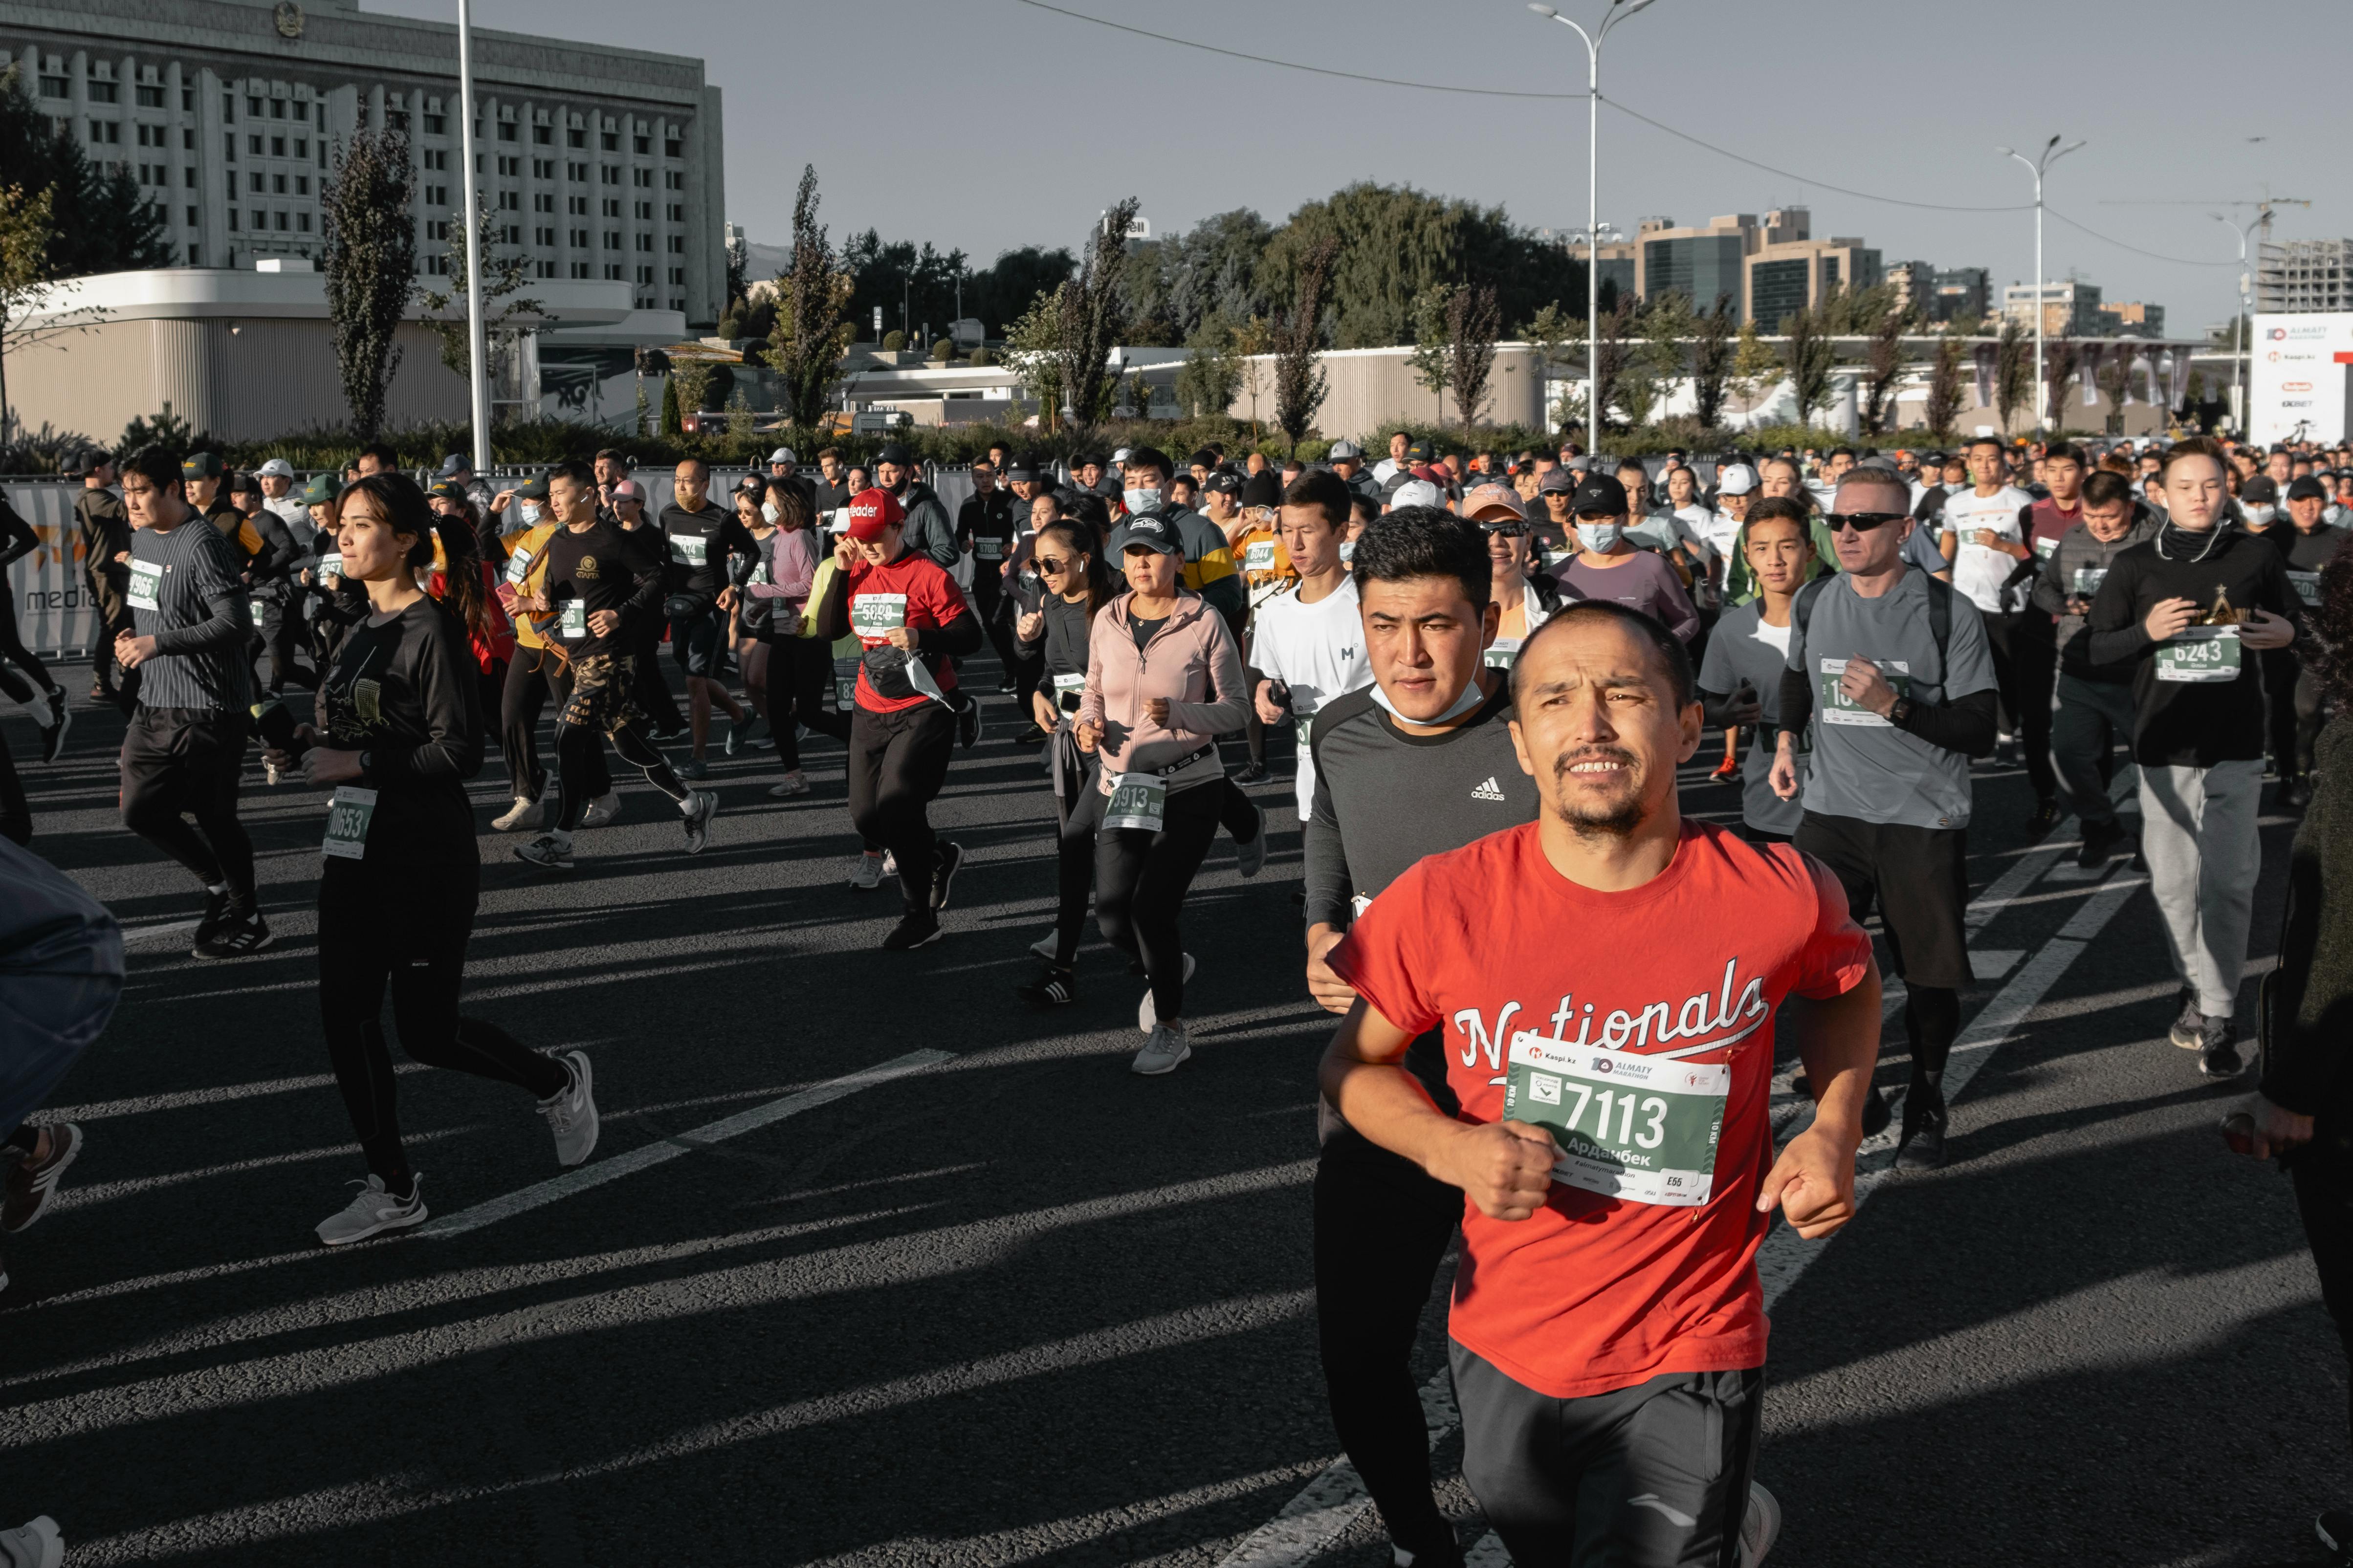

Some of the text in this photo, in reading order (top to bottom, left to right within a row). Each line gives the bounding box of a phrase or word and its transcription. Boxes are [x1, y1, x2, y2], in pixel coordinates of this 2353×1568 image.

[980, 544, 997, 553] 8700
[2175, 641, 2222, 661] 6243
[1114, 787, 1148, 808] 5913
[1471, 790, 1505, 801] adidas
[329, 807, 363, 838] 10653
[1545, 1053, 1576, 1064] Kaspi.kz
[1613, 1070, 1649, 1080] MARATHON
[1615, 1062, 1652, 1074] ALMATY
[1565, 1082, 1668, 1149] 7113
[1567, 1137, 1651, 1167] Арданбек
[1575, 1160, 1635, 1178] #almatymarathon
